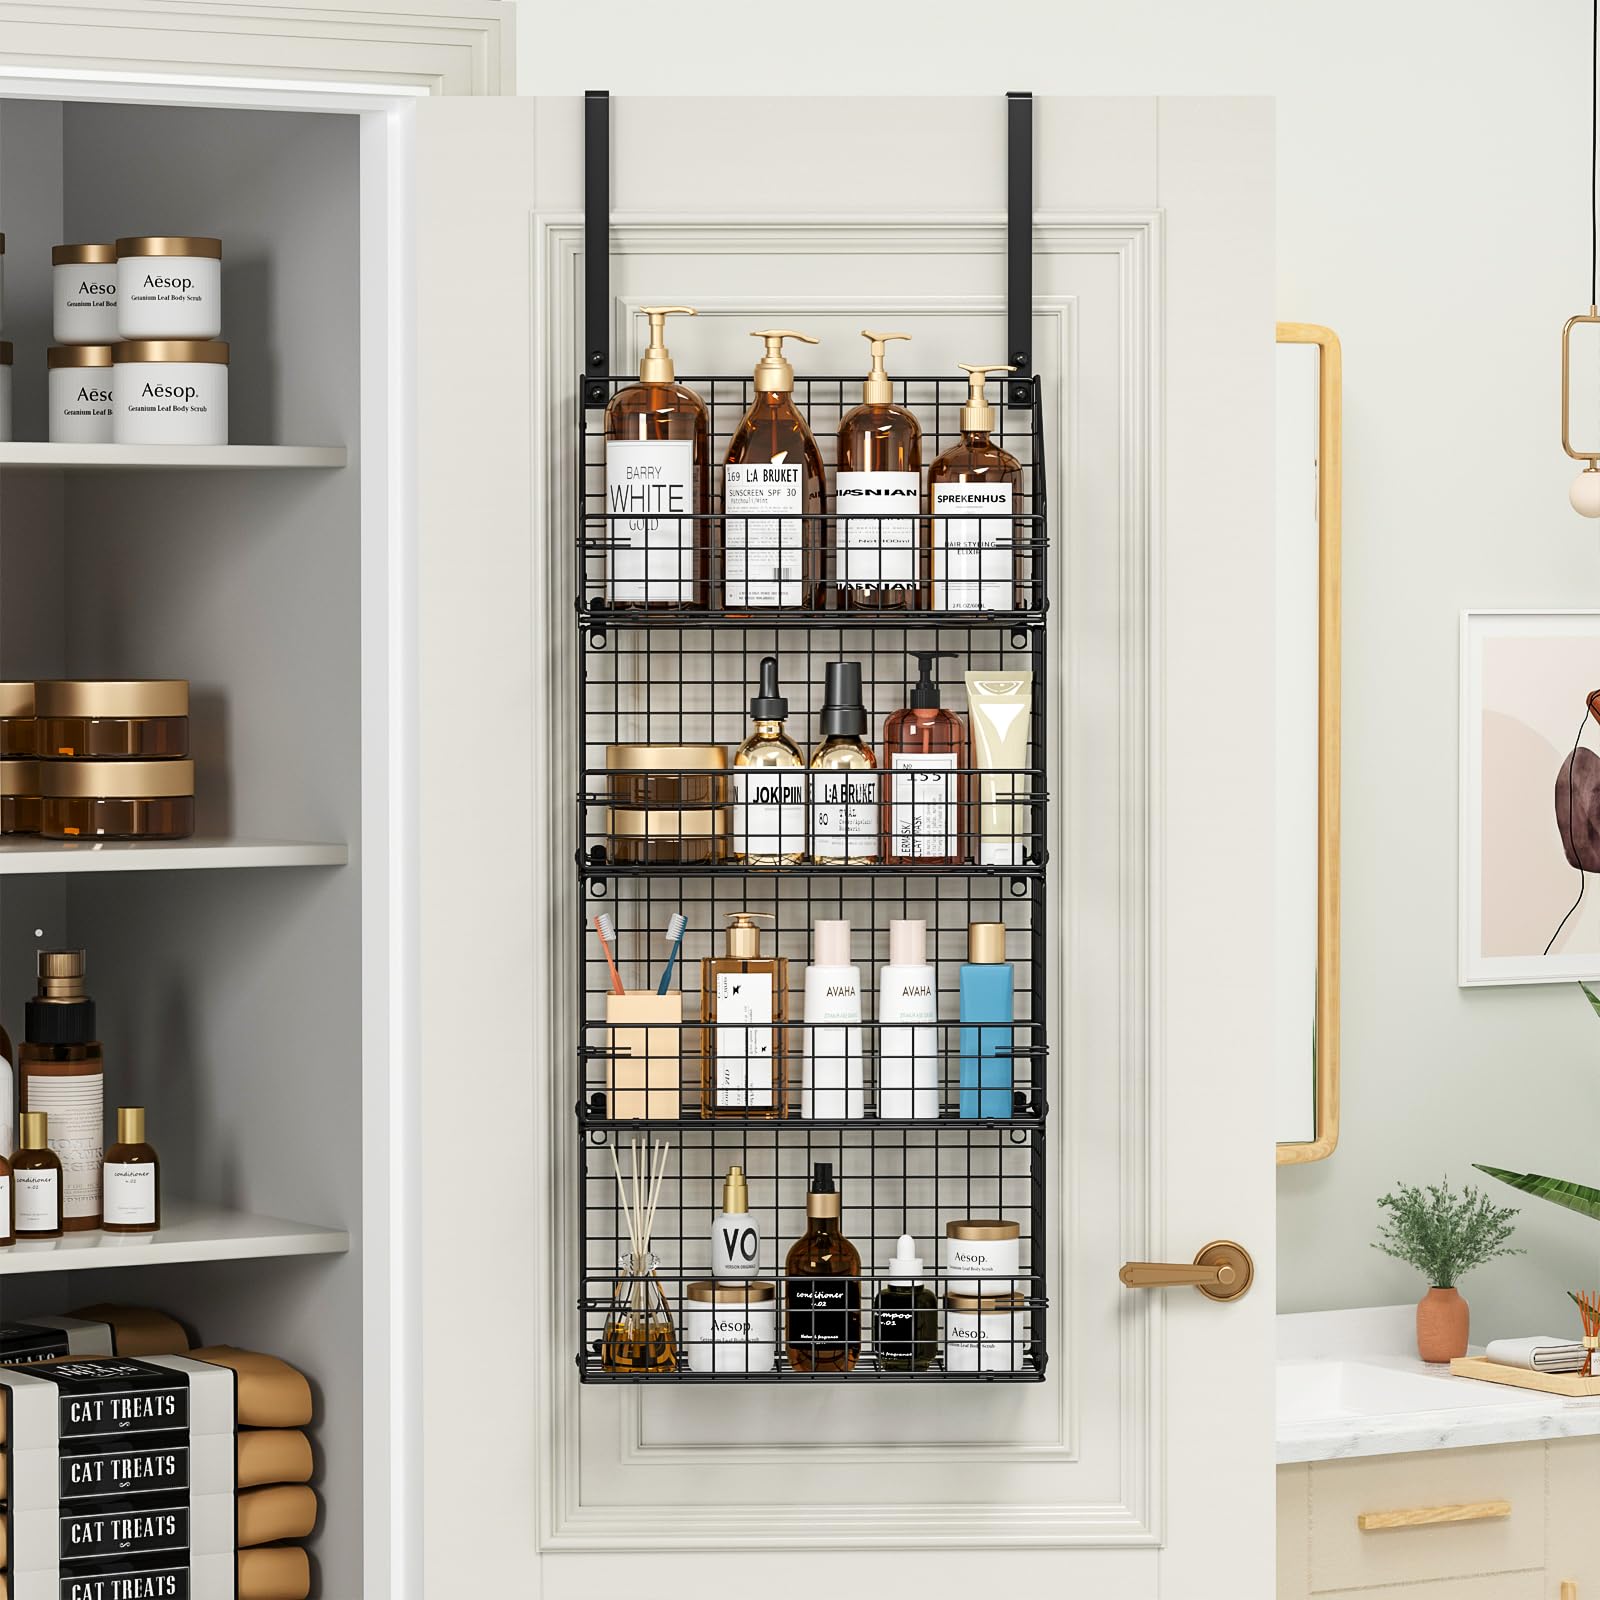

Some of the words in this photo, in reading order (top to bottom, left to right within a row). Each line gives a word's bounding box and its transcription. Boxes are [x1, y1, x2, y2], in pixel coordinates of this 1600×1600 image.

[171, 294, 186, 302] Body
[92, 408, 107, 416] Leaf
[157, 404, 172, 412] Leaf
[172, 405, 189, 414] Body
[626, 466, 662, 480] BARRY
[727, 471, 741, 482] 169
[762, 468, 799, 483] BRUKET
[610, 484, 684, 513] WHITE
[729, 488, 764, 497] SUNSCREEN
[767, 488, 782, 497] SPF
[786, 488, 797, 497] 30
[937, 494, 1007, 504] SPREKENHUS
[840, 782, 876, 804] BRUKET
[826, 985, 856, 997] AVAHA
[902, 985, 932, 997] AVAHA
[722, 1227, 758, 1262] VO
[71, 1400, 104, 1423] CAT
[110, 1394, 175, 1420] TREATS
[71, 1460, 104, 1484] CAT
[110, 1454, 176, 1480] TREATS
[71, 1520, 104, 1544] CAT
[110, 1514, 176, 1540] TREATS
[71, 1580, 104, 1600] CAT
[110, 1574, 176, 1600] TREATS
